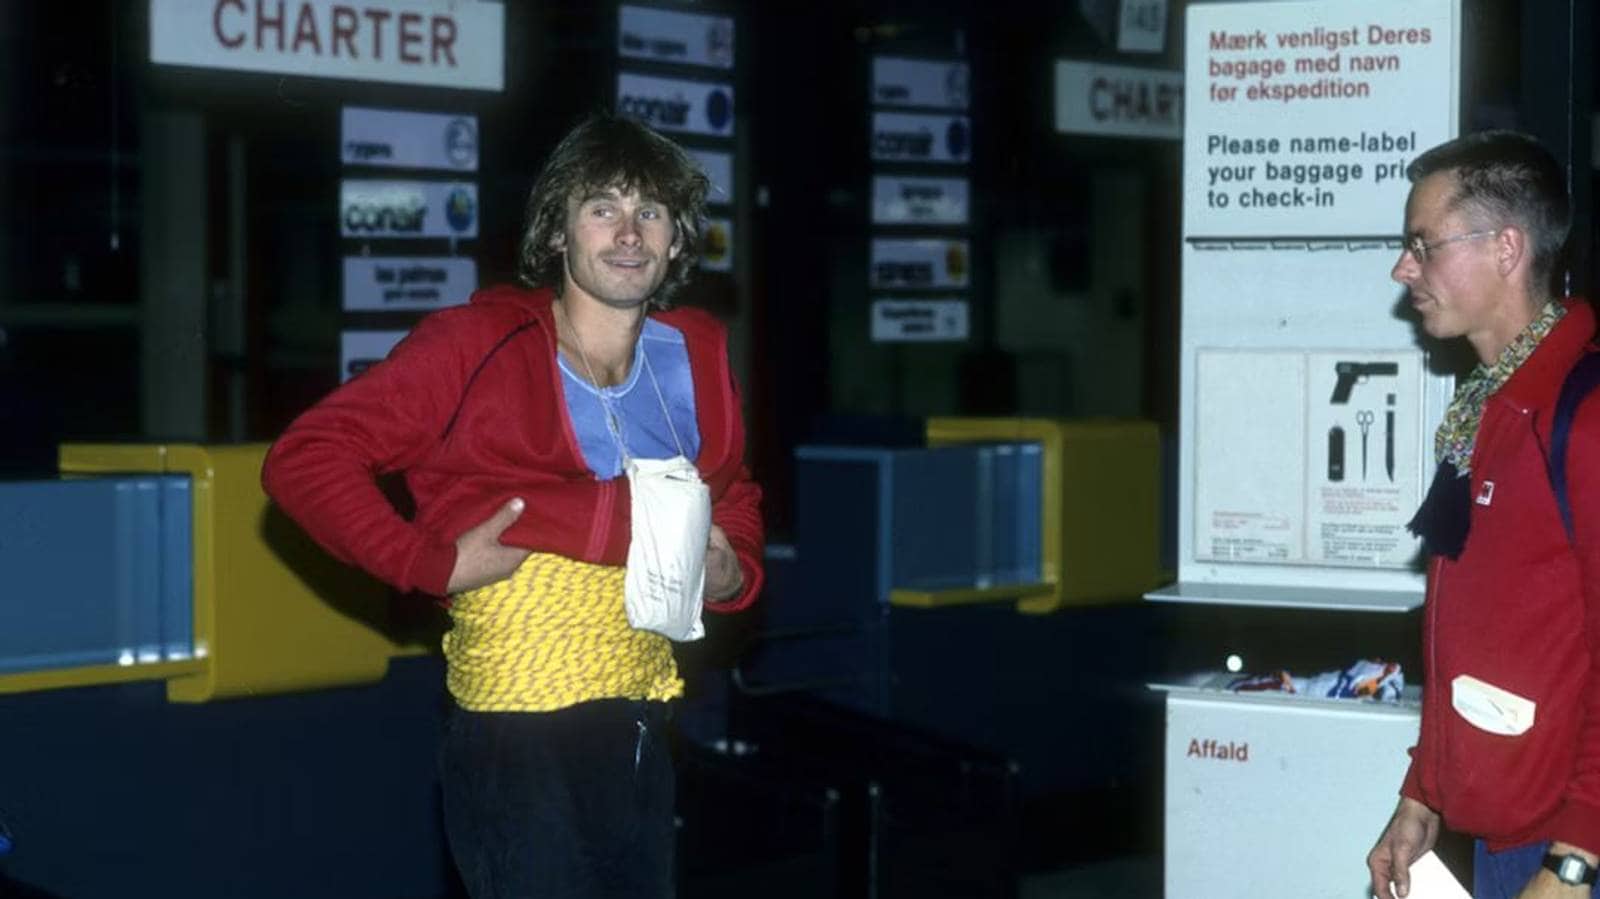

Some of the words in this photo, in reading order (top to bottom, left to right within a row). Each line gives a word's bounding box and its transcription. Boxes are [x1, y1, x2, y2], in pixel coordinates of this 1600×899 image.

[213, 0, 458, 67] CHARTER
[1209, 30, 1267, 50] Mærk
[1276, 27, 1360, 49] venligst
[1367, 25, 1432, 44] Deres
[1209, 58, 1286, 79] bagage
[1294, 53, 1341, 73] med
[1350, 55, 1400, 71] navn
[1210, 83, 1238, 101] før
[1246, 78, 1370, 103] ekspedition
[1208, 135, 1280, 154] Please
[1290, 132, 1417, 152] name-label
[1208, 165, 1256, 185] your
[1266, 161, 1363, 184] baggage
[1208, 190, 1229, 207] to
[1239, 187, 1335, 207] check-in
[346, 196, 427, 232] conair
[1187, 738, 1249, 762] Affald
